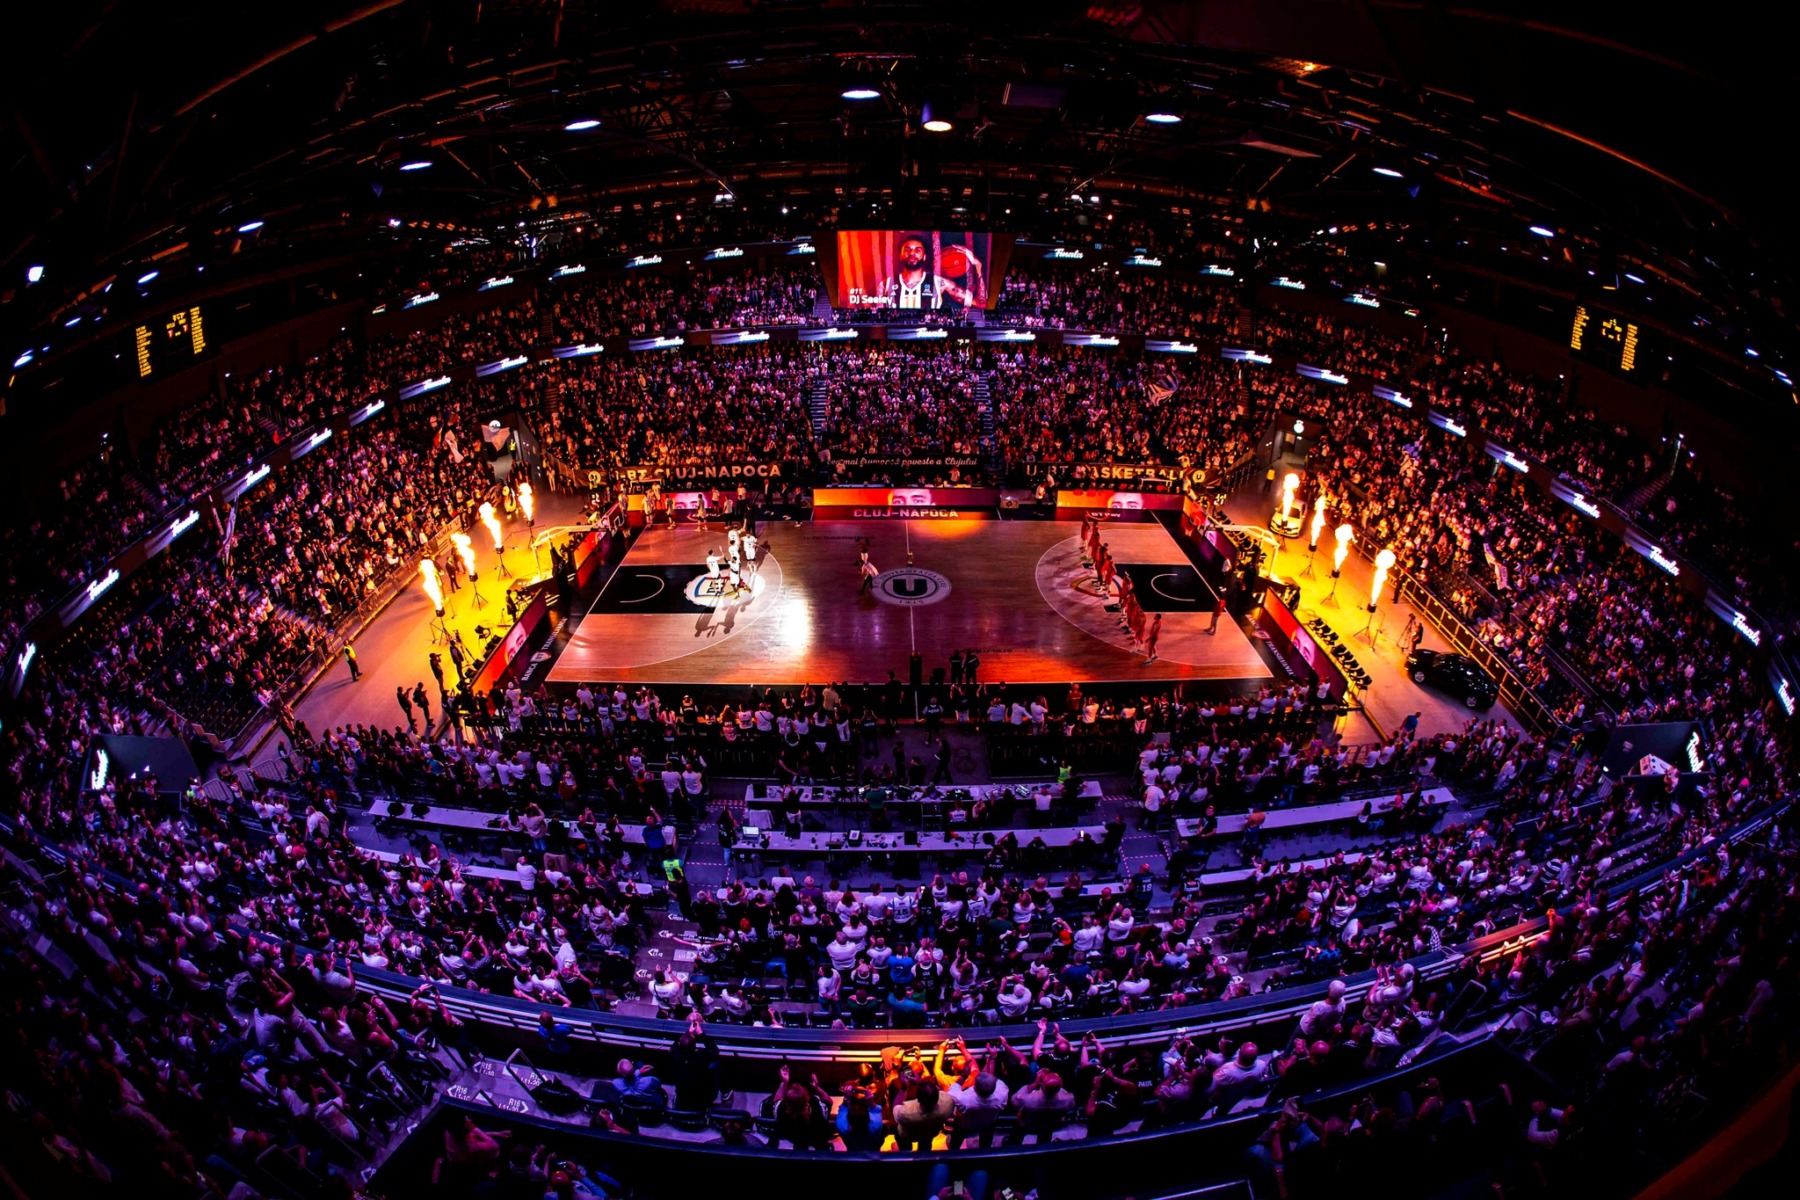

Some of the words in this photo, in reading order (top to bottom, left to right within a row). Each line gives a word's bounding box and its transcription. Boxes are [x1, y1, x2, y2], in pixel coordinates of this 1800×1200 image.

[713, 247, 744, 258] Finala
[1054, 247, 1084, 259] Finala
[633, 254, 662, 266] Finala
[1134, 254, 1162, 266] Finala
[850, 295, 860, 304] DJ
[854, 509, 959, 518] CLUJ-NAPOCA
[892, 579, 928, 596] U
[1138, 1080, 1153, 1088] PAUL
